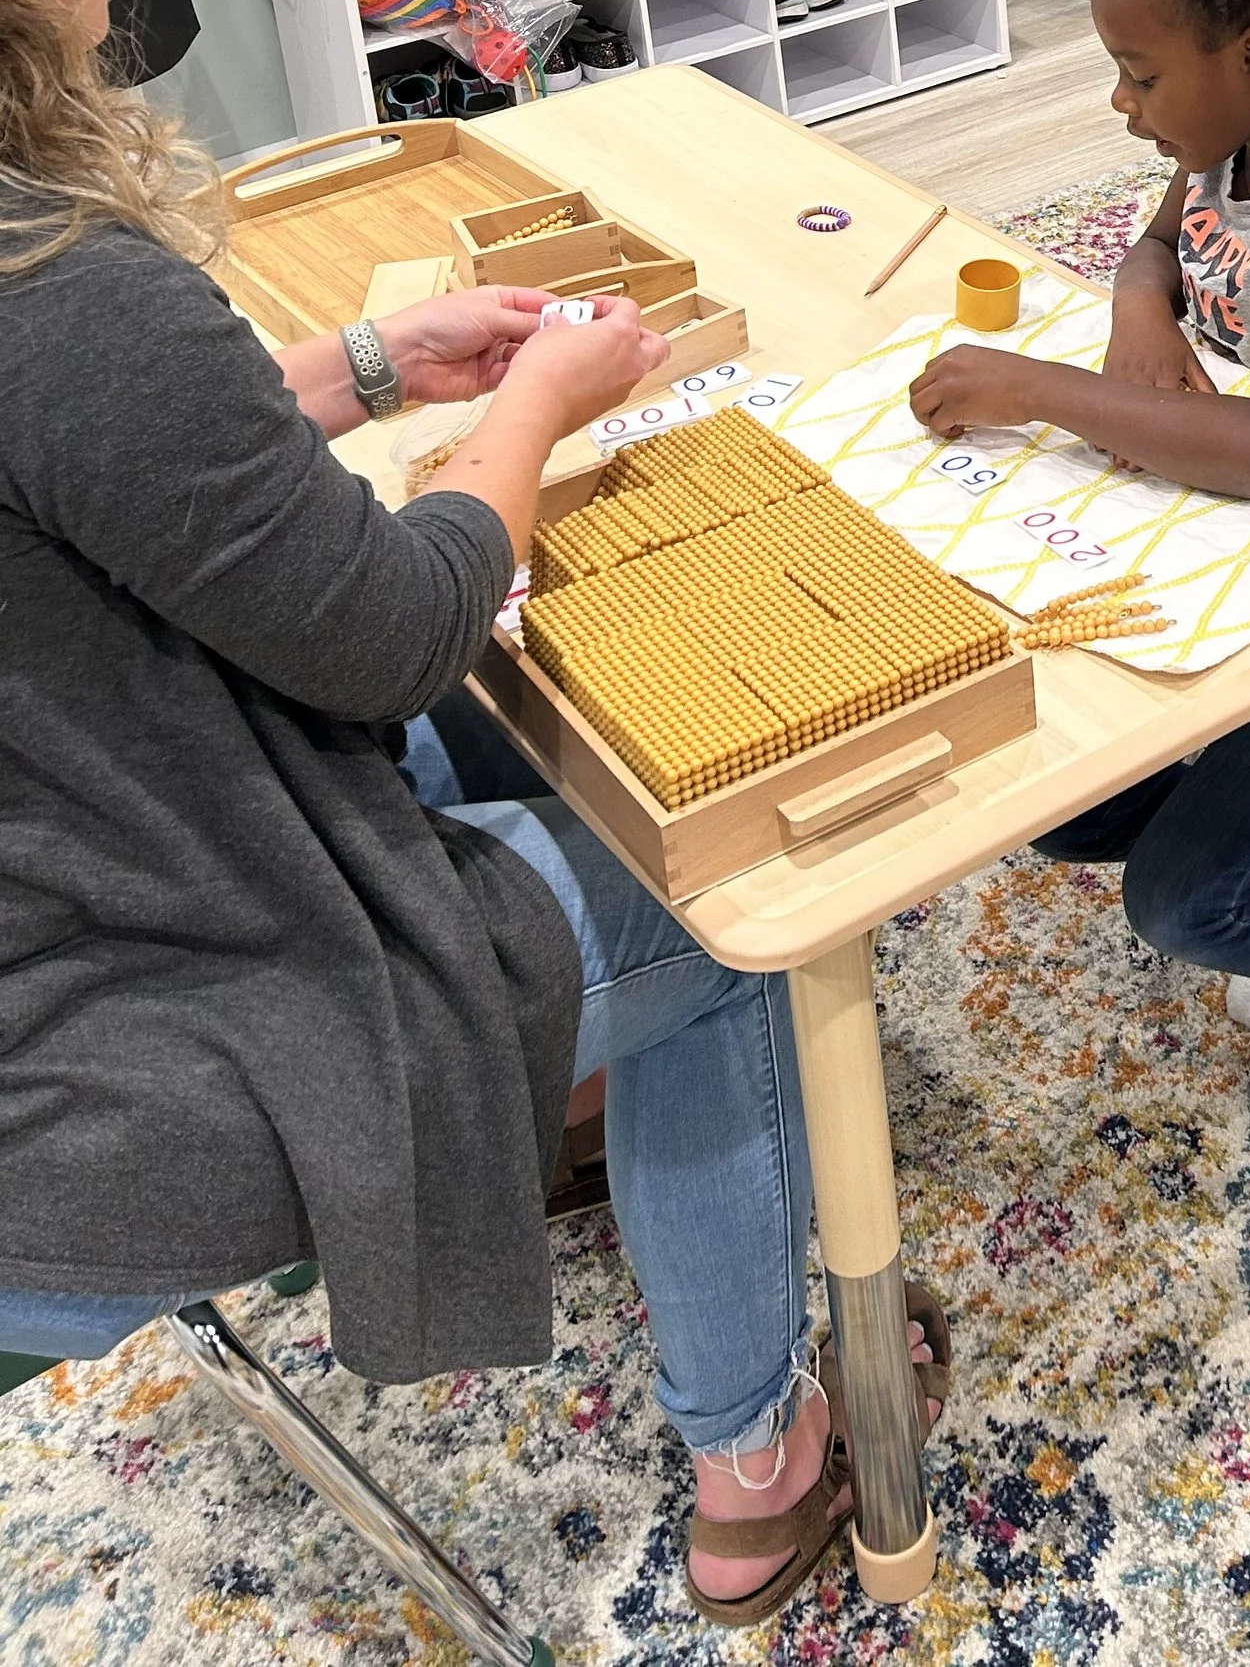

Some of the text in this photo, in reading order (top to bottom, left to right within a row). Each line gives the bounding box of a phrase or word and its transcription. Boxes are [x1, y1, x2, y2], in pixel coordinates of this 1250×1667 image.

[603, 397, 694, 435] 100
[941, 456, 997, 485] 50
[1023, 512, 1107, 562] 200
